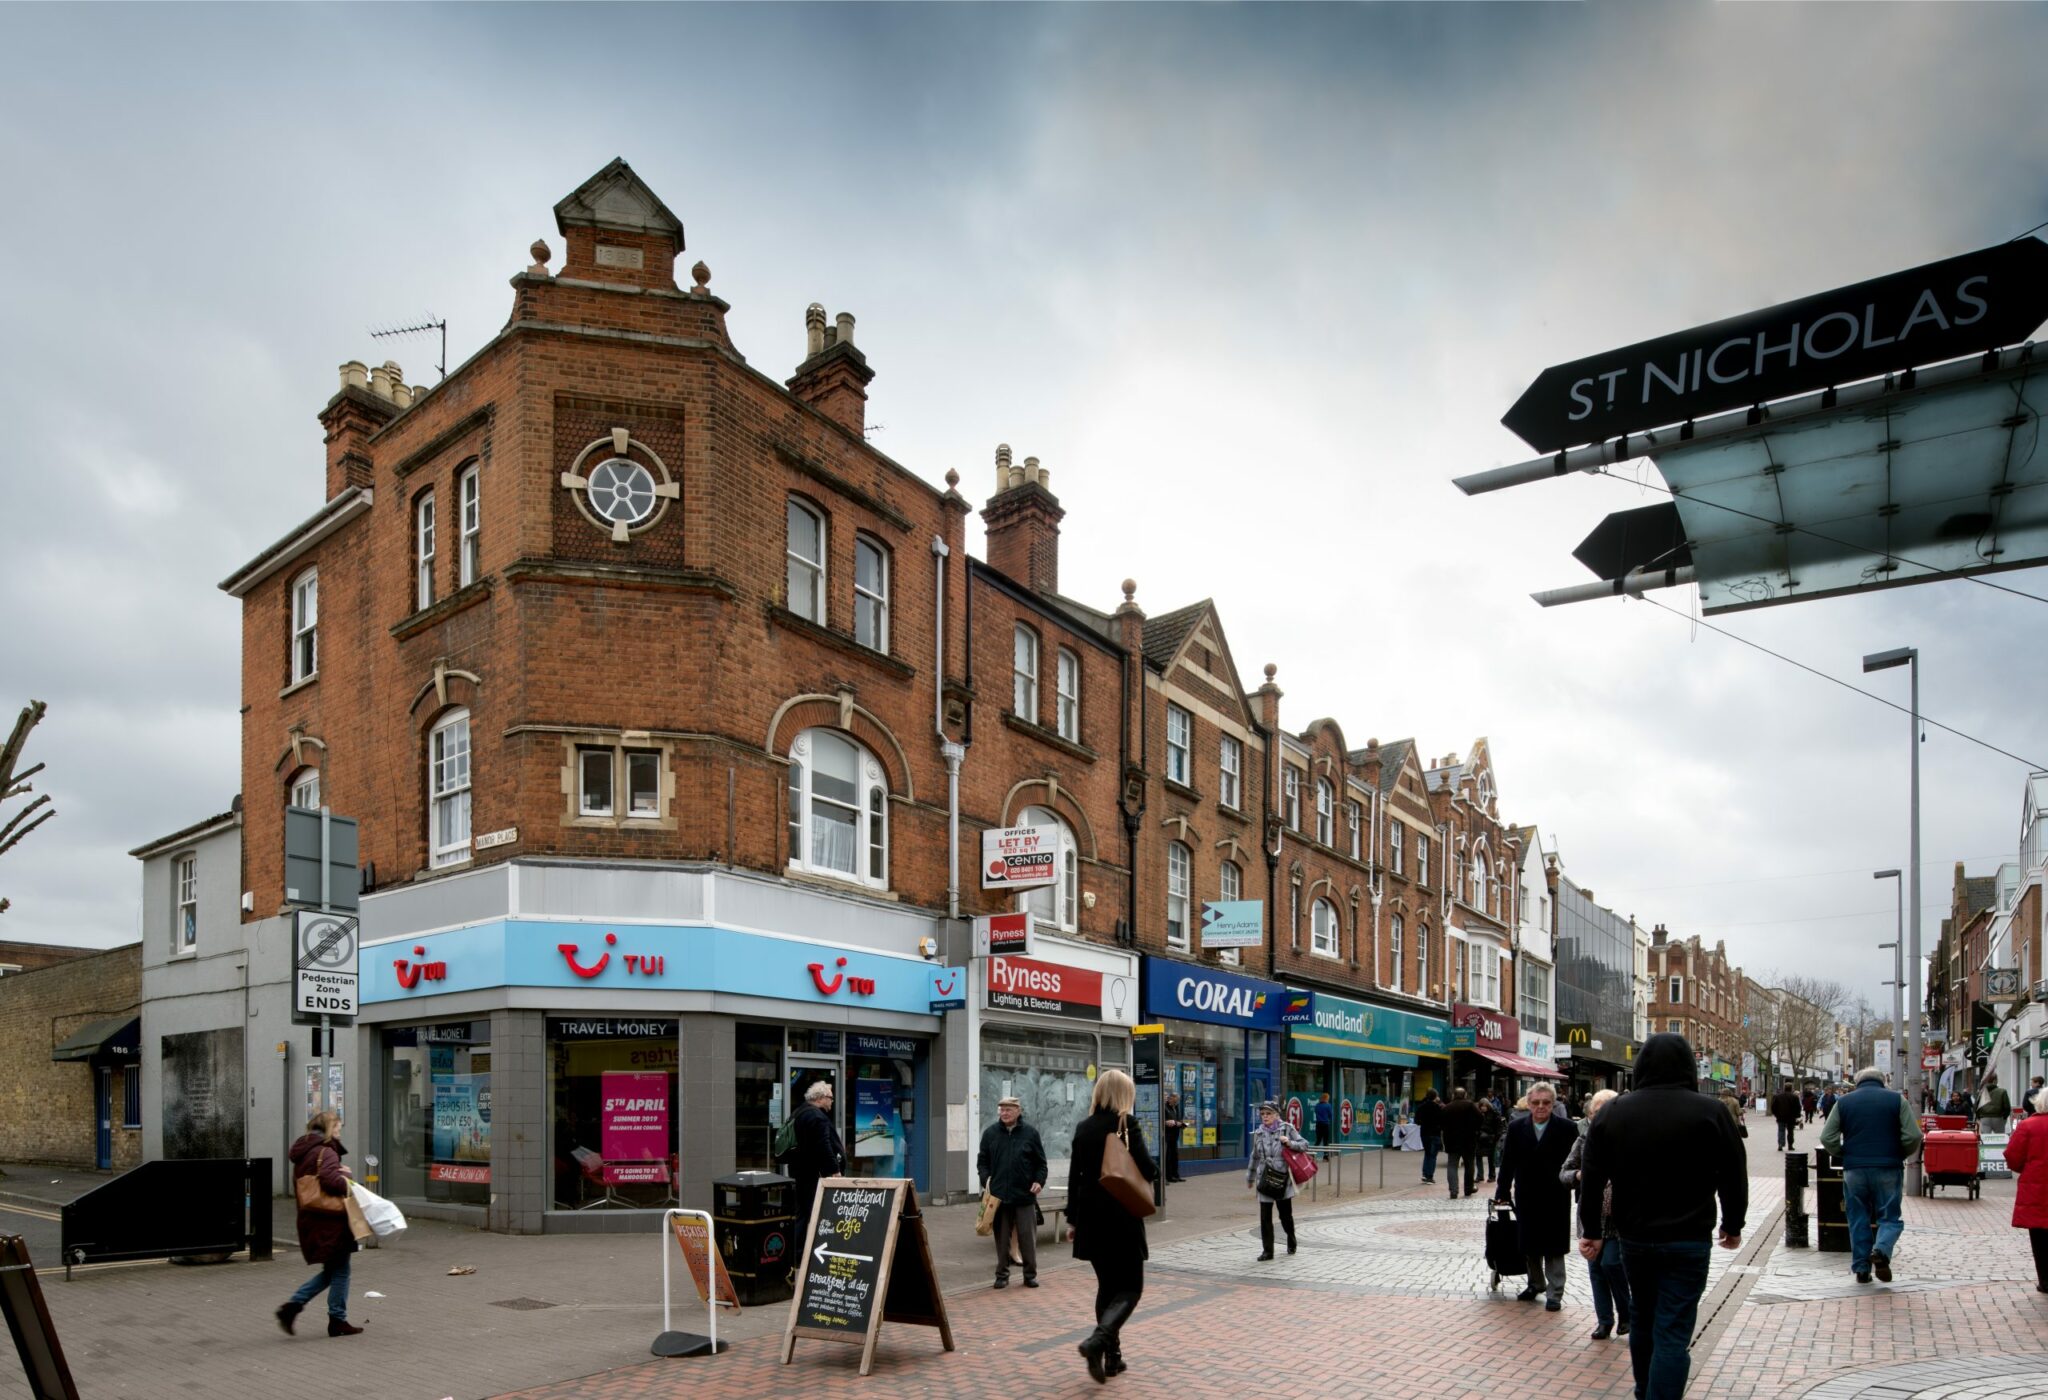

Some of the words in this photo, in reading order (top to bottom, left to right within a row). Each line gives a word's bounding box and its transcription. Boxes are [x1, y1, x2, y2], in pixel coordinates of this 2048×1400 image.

[1642, 275, 1989, 404] NICHOLAS
[476, 835, 496, 848] MANOR
[497, 829, 517, 844] PLACE
[1004, 828, 1036, 837] OFFICES
[998, 838, 1020, 848] LET
[1024, 836, 1040, 846] BY
[992, 929, 1025, 941] Ryness
[623, 955, 664, 976] TUI
[301, 973, 355, 986] Pedestrian
[993, 957, 1061, 993] Ryness
[316, 984, 341, 995] Zone
[847, 976, 876, 996] TUI
[305, 996, 351, 1011] ENDS
[993, 992, 1022, 1008] Lighting
[1023, 997, 1030, 1007] &
[1030, 997, 1062, 1012] Electrical
[1177, 977, 1254, 1018] CORAL
[1282, 1014, 1311, 1022] CORAL
[1313, 1009, 1363, 1034] oundland
[416, 1029, 441, 1042] TRAVEL
[441, 1027, 465, 1040] MONEY
[560, 1022, 614, 1035] TRAVEL
[617, 1023, 667, 1036] MONEY
[112, 1046, 128, 1054] 186
[858, 1037, 888, 1049] TRAVEL
[889, 1040, 917, 1052] MONEY
[437, 1101, 472, 1113] DEPOSITS
[605, 1098, 625, 1112] 5TH
[625, 1099, 666, 1111] APRIL
[437, 1115, 457, 1127] FROM
[459, 1115, 472, 1127] £50
[613, 1115, 641, 1123] SUMMER
[641, 1115, 658, 1123] 2019
[1341, 1108, 1351, 1128] £1
[1375, 1109, 1384, 1128] £1
[439, 1167, 458, 1180] SALE
[457, 1168, 475, 1181] NOW
[475, 1169, 487, 1181] ON
[832, 1189, 887, 1208] traditional
[837, 1203, 870, 1222] english
[677, 1225, 709, 1238] PECKISH
[809, 1273, 846, 1292] Breakfast
[848, 1279, 857, 1290] all
[856, 1280, 870, 1300] day
